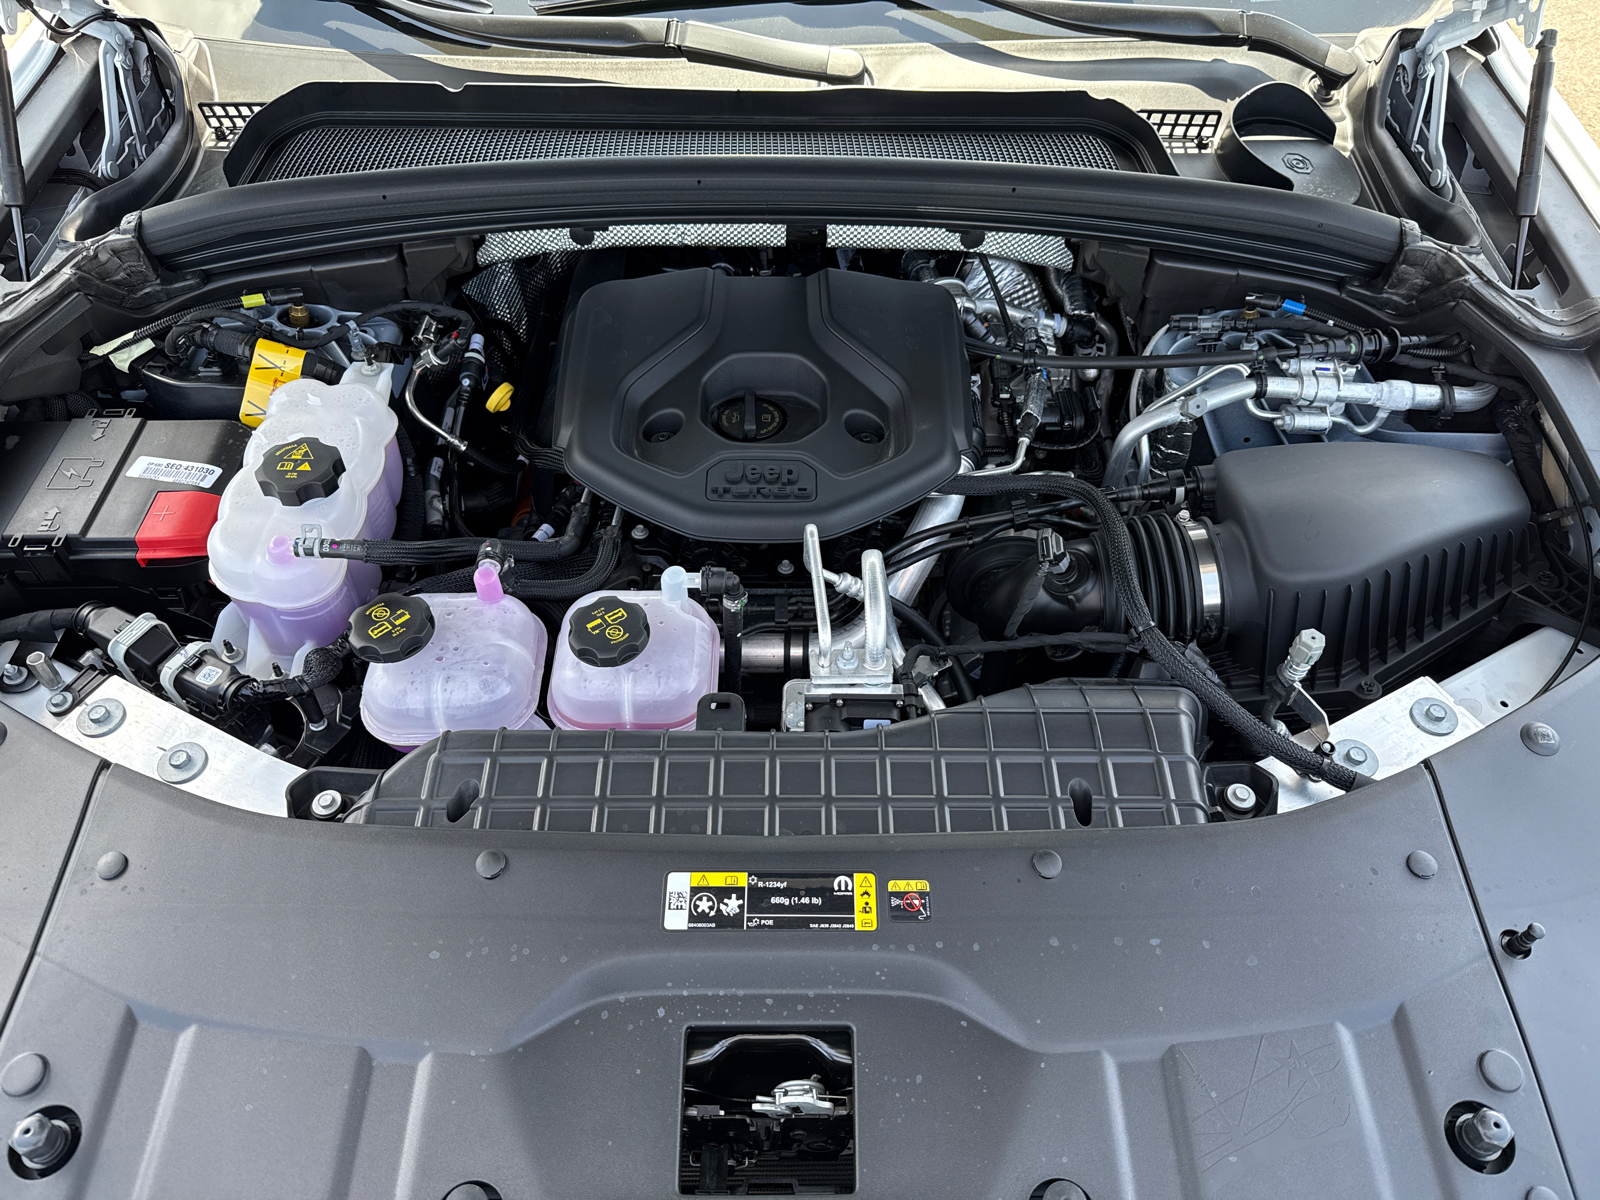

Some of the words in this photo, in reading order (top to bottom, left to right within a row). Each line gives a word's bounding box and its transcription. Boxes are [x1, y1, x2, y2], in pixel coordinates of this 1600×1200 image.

[725, 460, 800, 486] Jeep
[711, 486, 814, 500] TURBO
[757, 881, 787, 889] R-1234yf
[770, 896, 790, 906] 660g
[791, 896, 810, 906] (1.46
[811, 896, 822, 906] lb)
